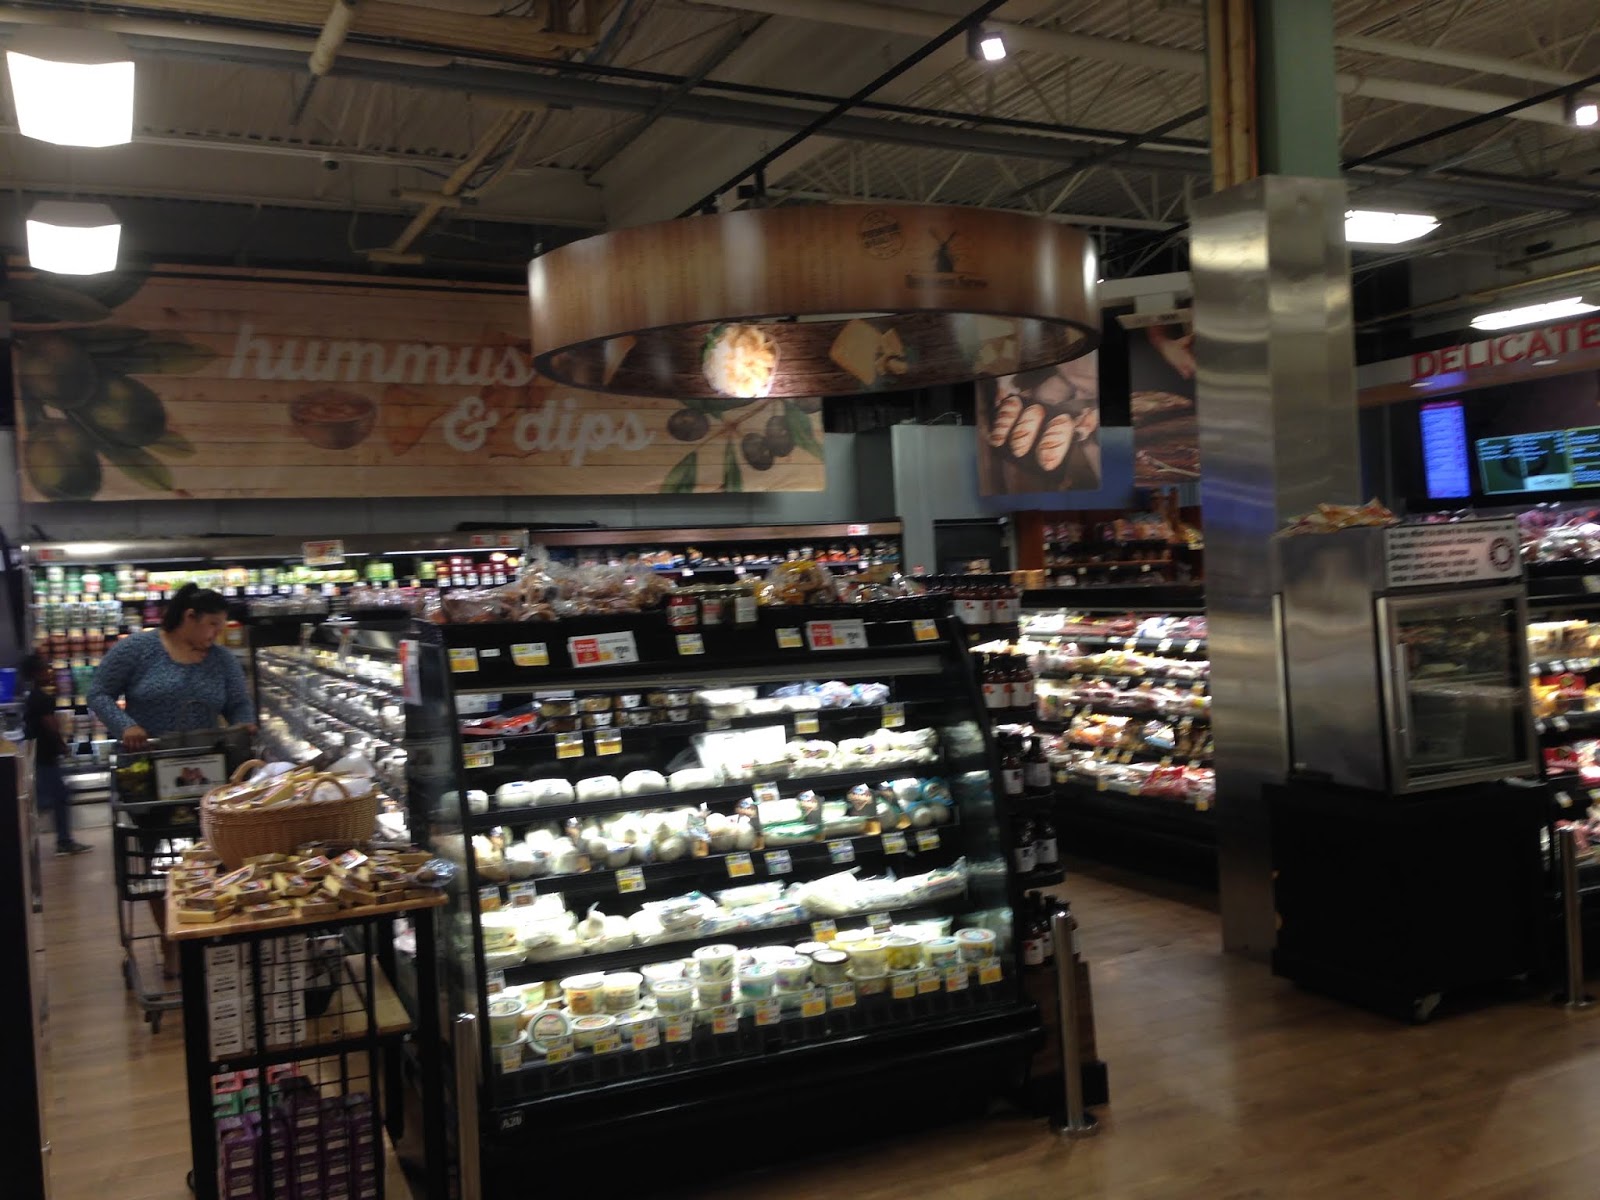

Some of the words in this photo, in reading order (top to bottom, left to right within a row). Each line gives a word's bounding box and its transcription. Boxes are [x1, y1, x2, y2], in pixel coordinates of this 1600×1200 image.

[227, 323, 533, 388] hummus
[1413, 318, 1600, 379] DELICATE
[444, 397, 498, 452] &
[515, 396, 655, 467] dips
